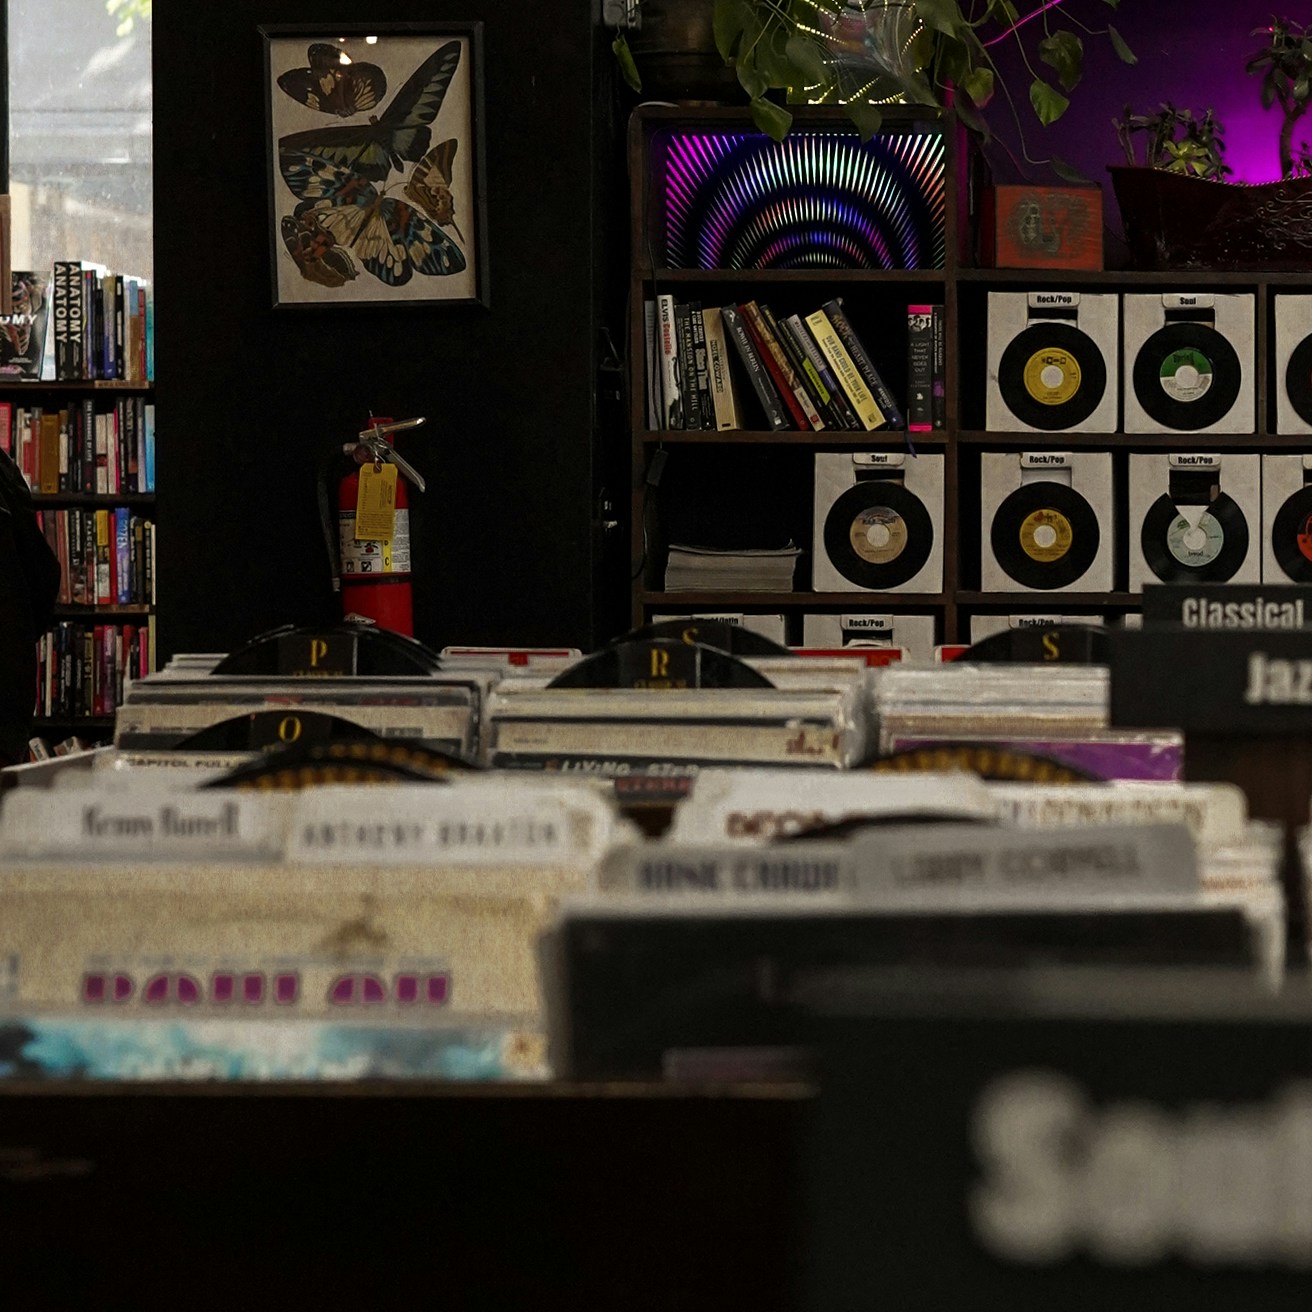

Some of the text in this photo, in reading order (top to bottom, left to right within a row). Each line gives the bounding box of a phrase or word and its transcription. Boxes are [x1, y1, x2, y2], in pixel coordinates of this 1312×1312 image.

[55, 264, 68, 343] ANATOMY
[69, 264, 81, 343] ANATOMY
[661, 298, 670, 322] ELVIS
[1036, 294, 1072, 304] Rock/Pop
[1179, 296, 1197, 305] Soul
[870, 454, 888, 463] Soul
[1028, 455, 1065, 464] Rock/Pop
[1177, 456, 1213, 465] Rock/Pop
[848, 618, 885, 628] Rock/Pop
[1181, 596, 1305, 630] Classical
[310, 639, 327, 666] P
[1042, 631, 1060, 661] S
[651, 648, 670, 677] R
[278, 716, 301, 743] O
